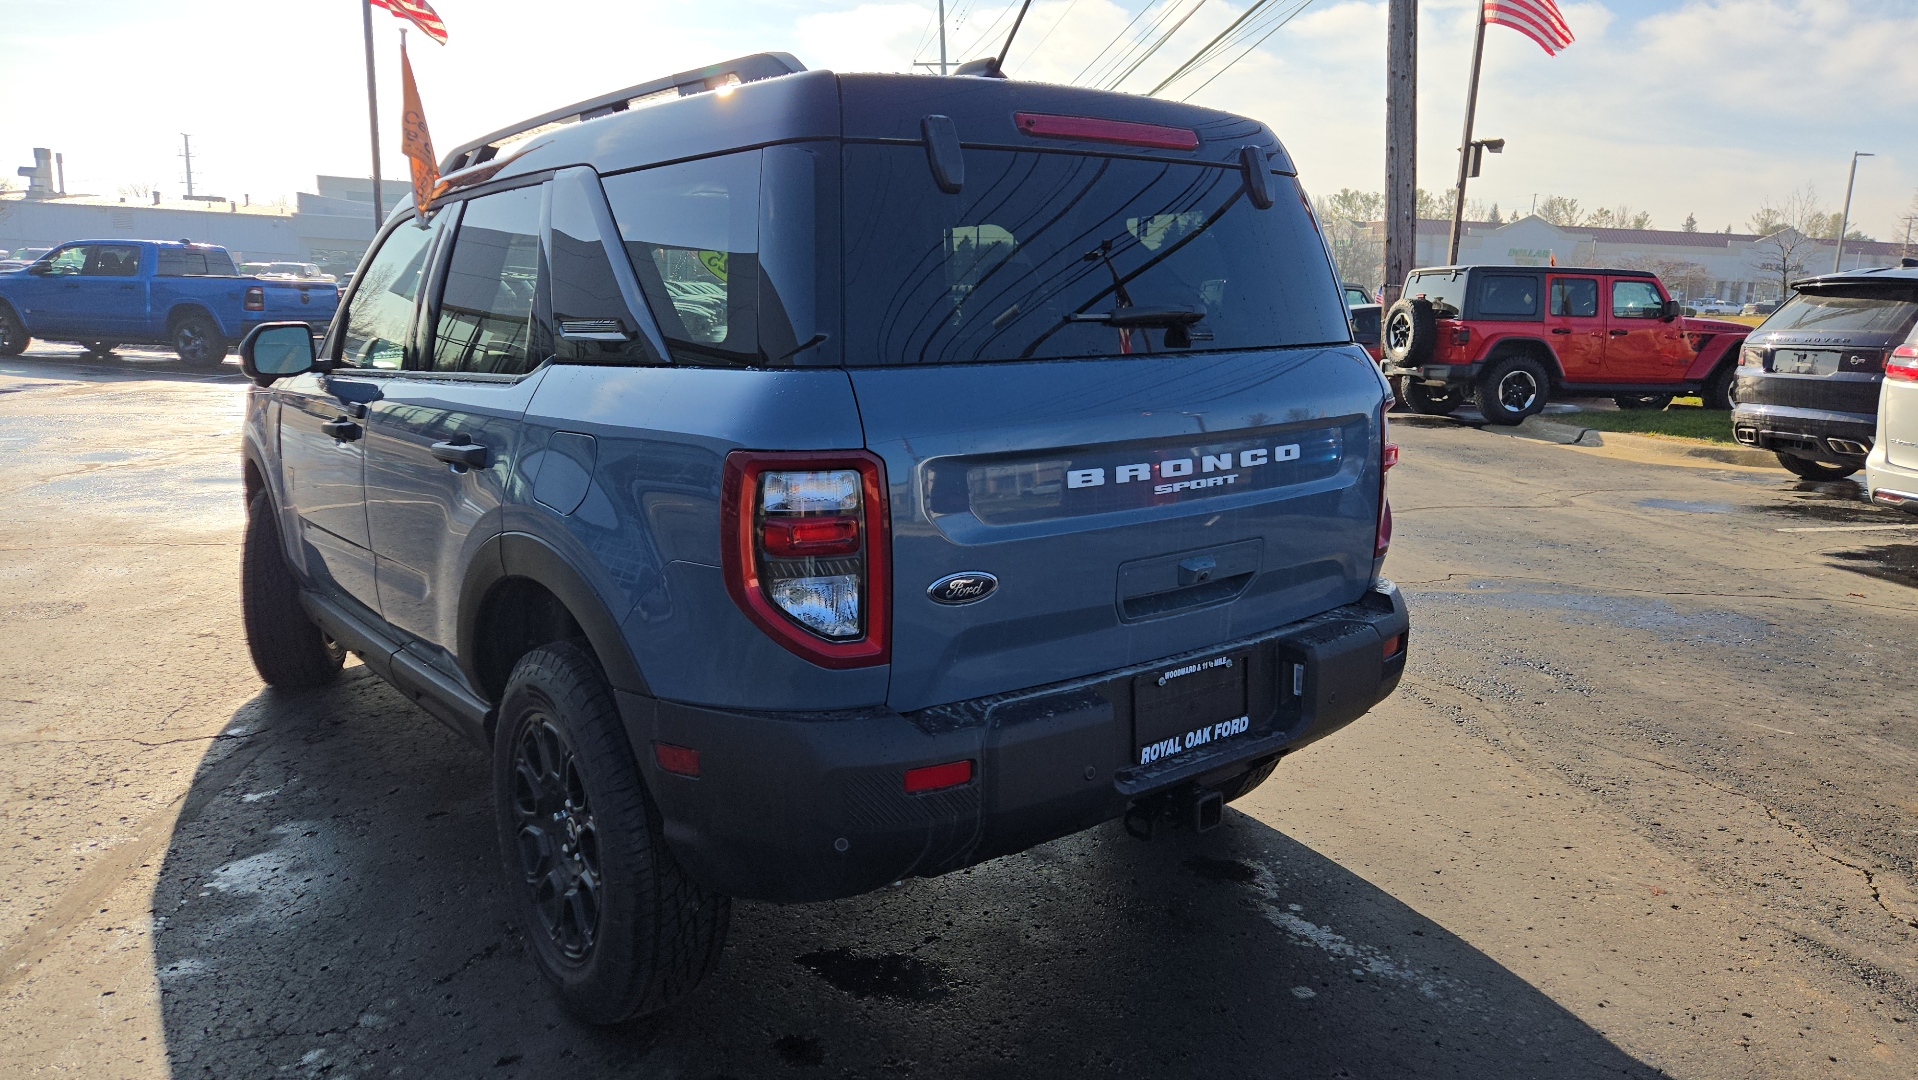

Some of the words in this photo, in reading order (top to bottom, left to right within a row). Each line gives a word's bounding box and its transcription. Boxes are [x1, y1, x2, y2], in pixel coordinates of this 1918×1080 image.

[1508, 248, 1550, 258] DOLLAR
[1804, 336, 1852, 344] ROVER
[1066, 443, 1301, 489] BRONCO
[1154, 473, 1239, 495] SPORT
[945, 578, 984, 599] Ford
[1165, 665, 1196, 680] WOODWARD
[1214, 657, 1227, 667] MILE
[1141, 737, 1181, 764] ROYAL
[1184, 725, 1213, 749] OAK
[1214, 716, 1249, 740] FORD
